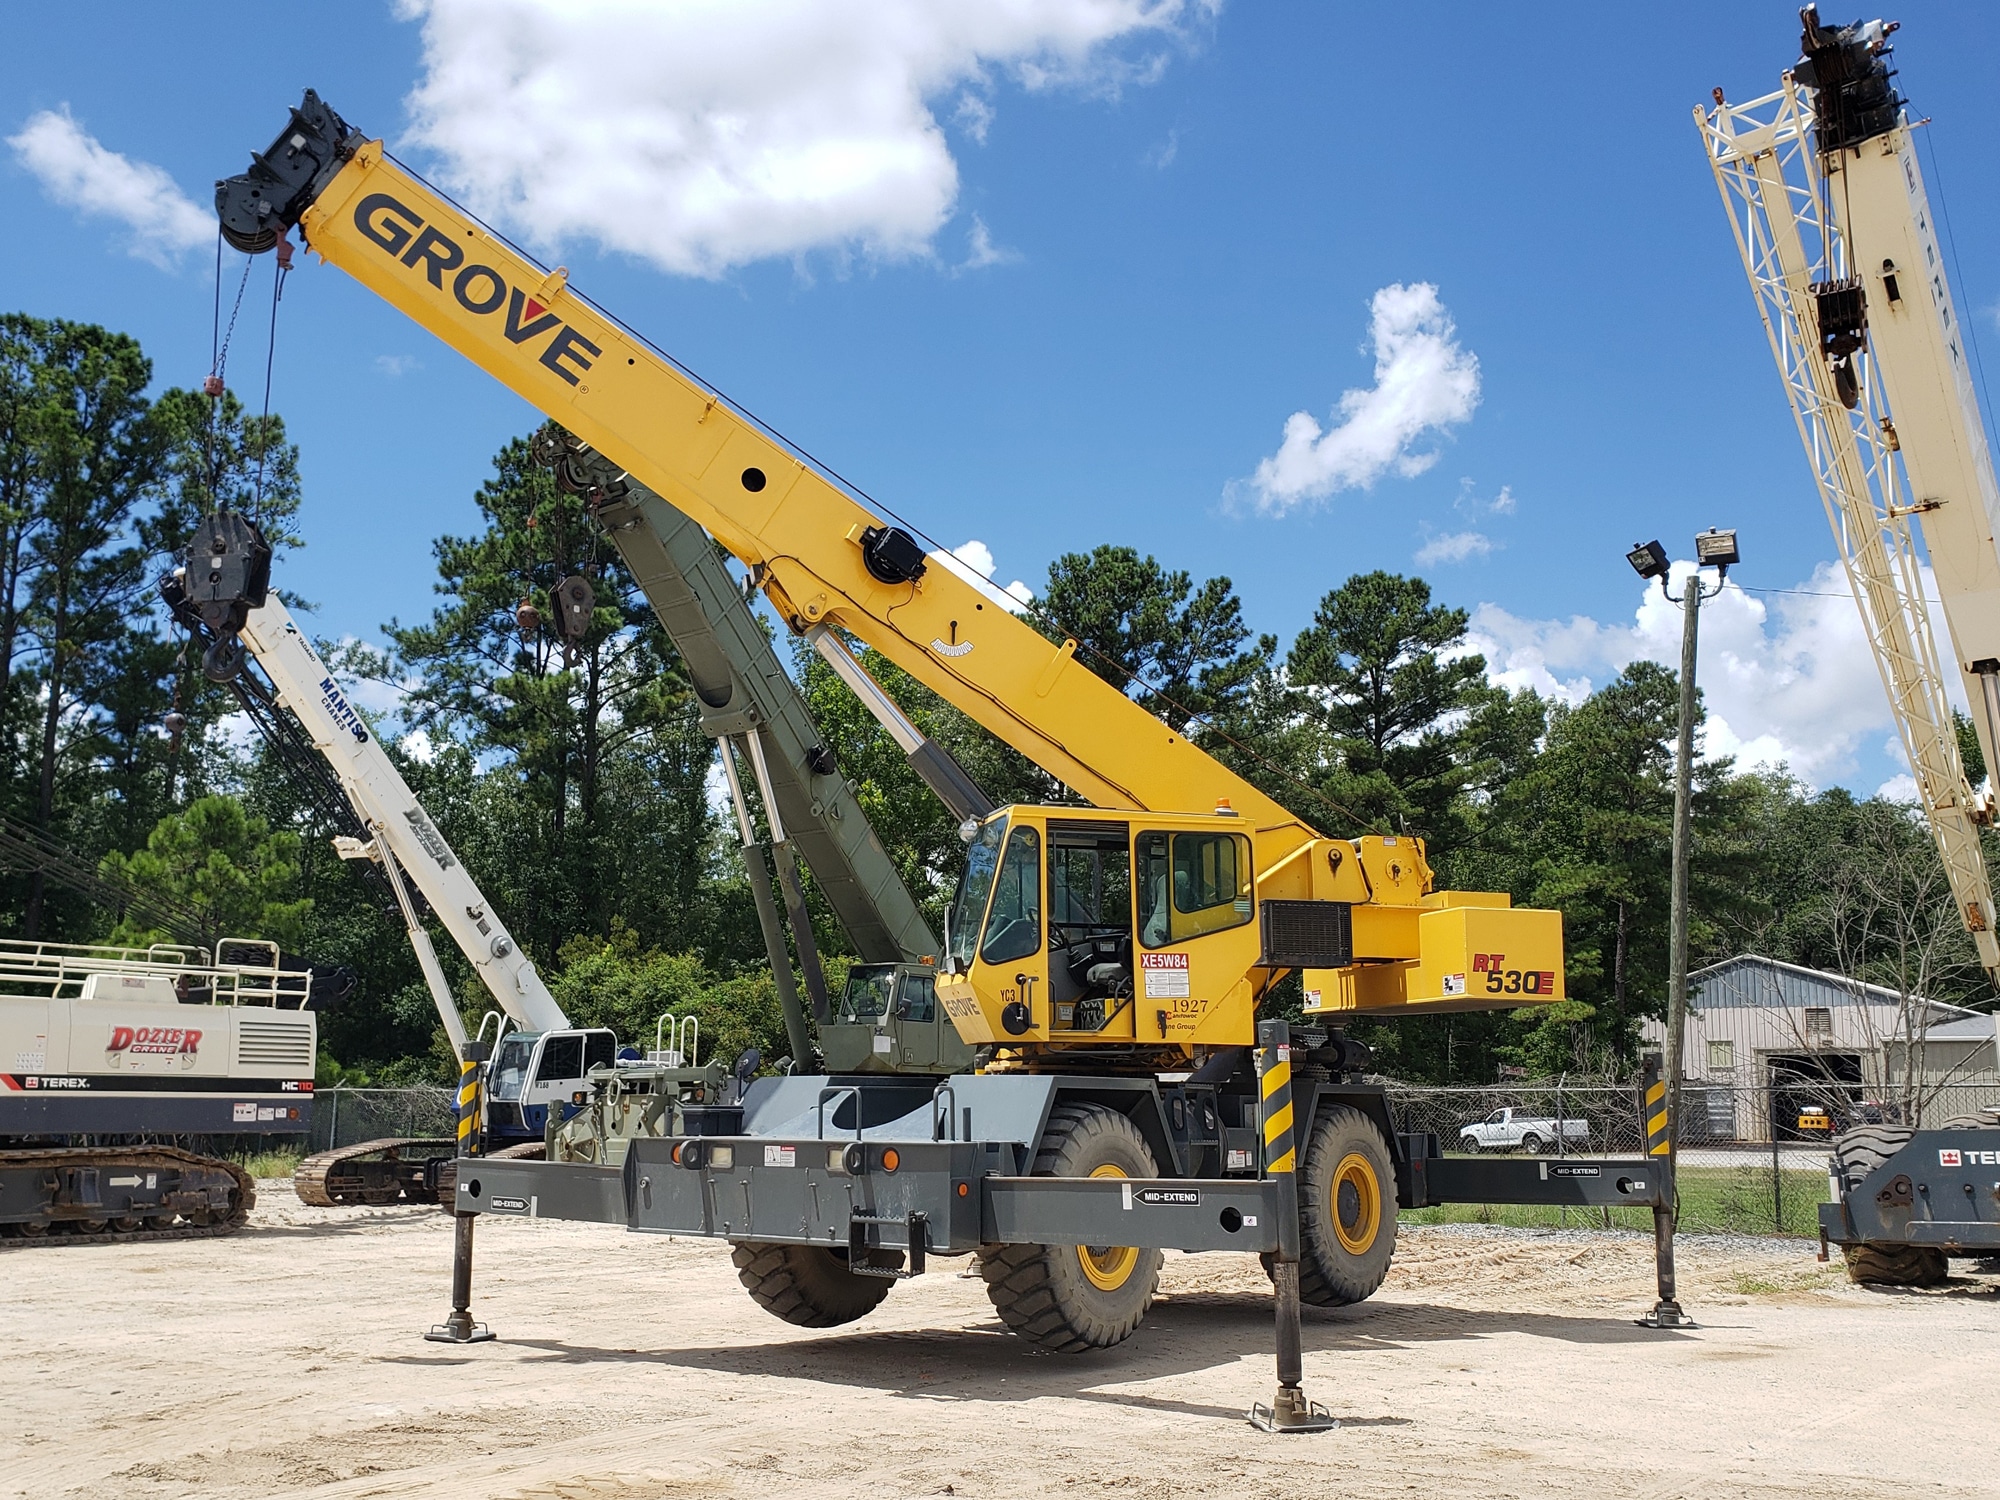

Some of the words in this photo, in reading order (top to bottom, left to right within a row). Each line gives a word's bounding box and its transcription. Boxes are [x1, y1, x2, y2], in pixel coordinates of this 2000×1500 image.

[354, 193, 602, 387] GROVE
[298, 637, 316, 662] TADANO
[319, 677, 363, 737] MANTIS
[321, 697, 346, 731] CRANES
[1141, 954, 1187, 968] XE5W84
[1473, 954, 1505, 972] RT
[1486, 970, 1555, 995] 530E
[1000, 989, 1015, 1002] YC3
[945, 997, 980, 1017] GROVE
[1172, 1000, 1208, 1013] 1927
[1177, 1023, 1196, 1031] Group
[106, 1026, 203, 1053] DOZIER
[131, 1045, 176, 1053] CRANE
[41, 1078, 88, 1088] TEREX
[282, 1081, 313, 1090] HC110
[493, 1200, 524, 1208] MID-EXTEND
[1144, 1192, 1197, 1202] MID-EXTEND
